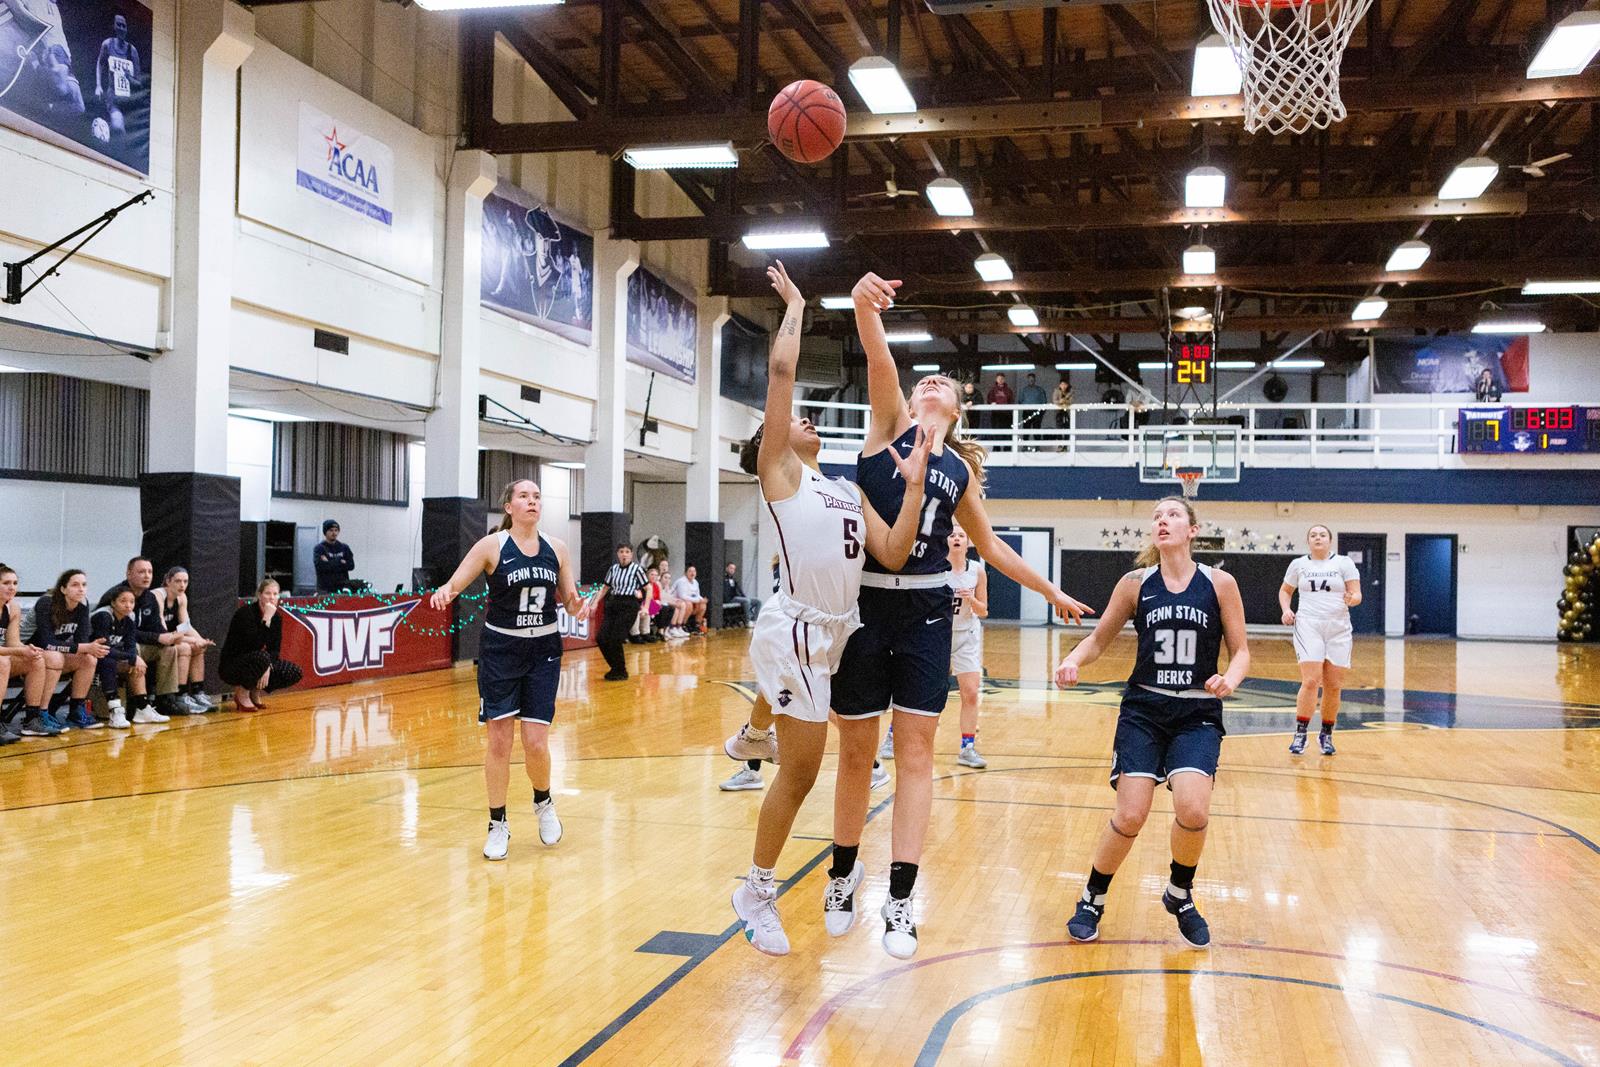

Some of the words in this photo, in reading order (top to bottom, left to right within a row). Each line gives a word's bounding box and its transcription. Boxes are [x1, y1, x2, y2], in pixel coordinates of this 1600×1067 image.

[329, 146, 379, 193] ACAA
[1178, 361, 1205, 382] 24
[1527, 408, 1572, 429] 6:03
[1487, 420, 1499, 441] 7
[929, 468, 959, 503] STATE
[920, 493, 941, 536] 1
[843, 518, 860, 559] 5
[507, 567, 530, 586] PENN
[532, 566, 557, 585] STATE
[1309, 580, 1331, 592] 14
[519, 587, 546, 613] 13
[516, 615, 544, 626] BERKS
[1146, 605, 1172, 628] PENN
[1176, 605, 1208, 628] STATE
[305, 610, 403, 669] UVF
[1154, 629, 1197, 665] 30
[1156, 670, 1193, 685] BERKS
